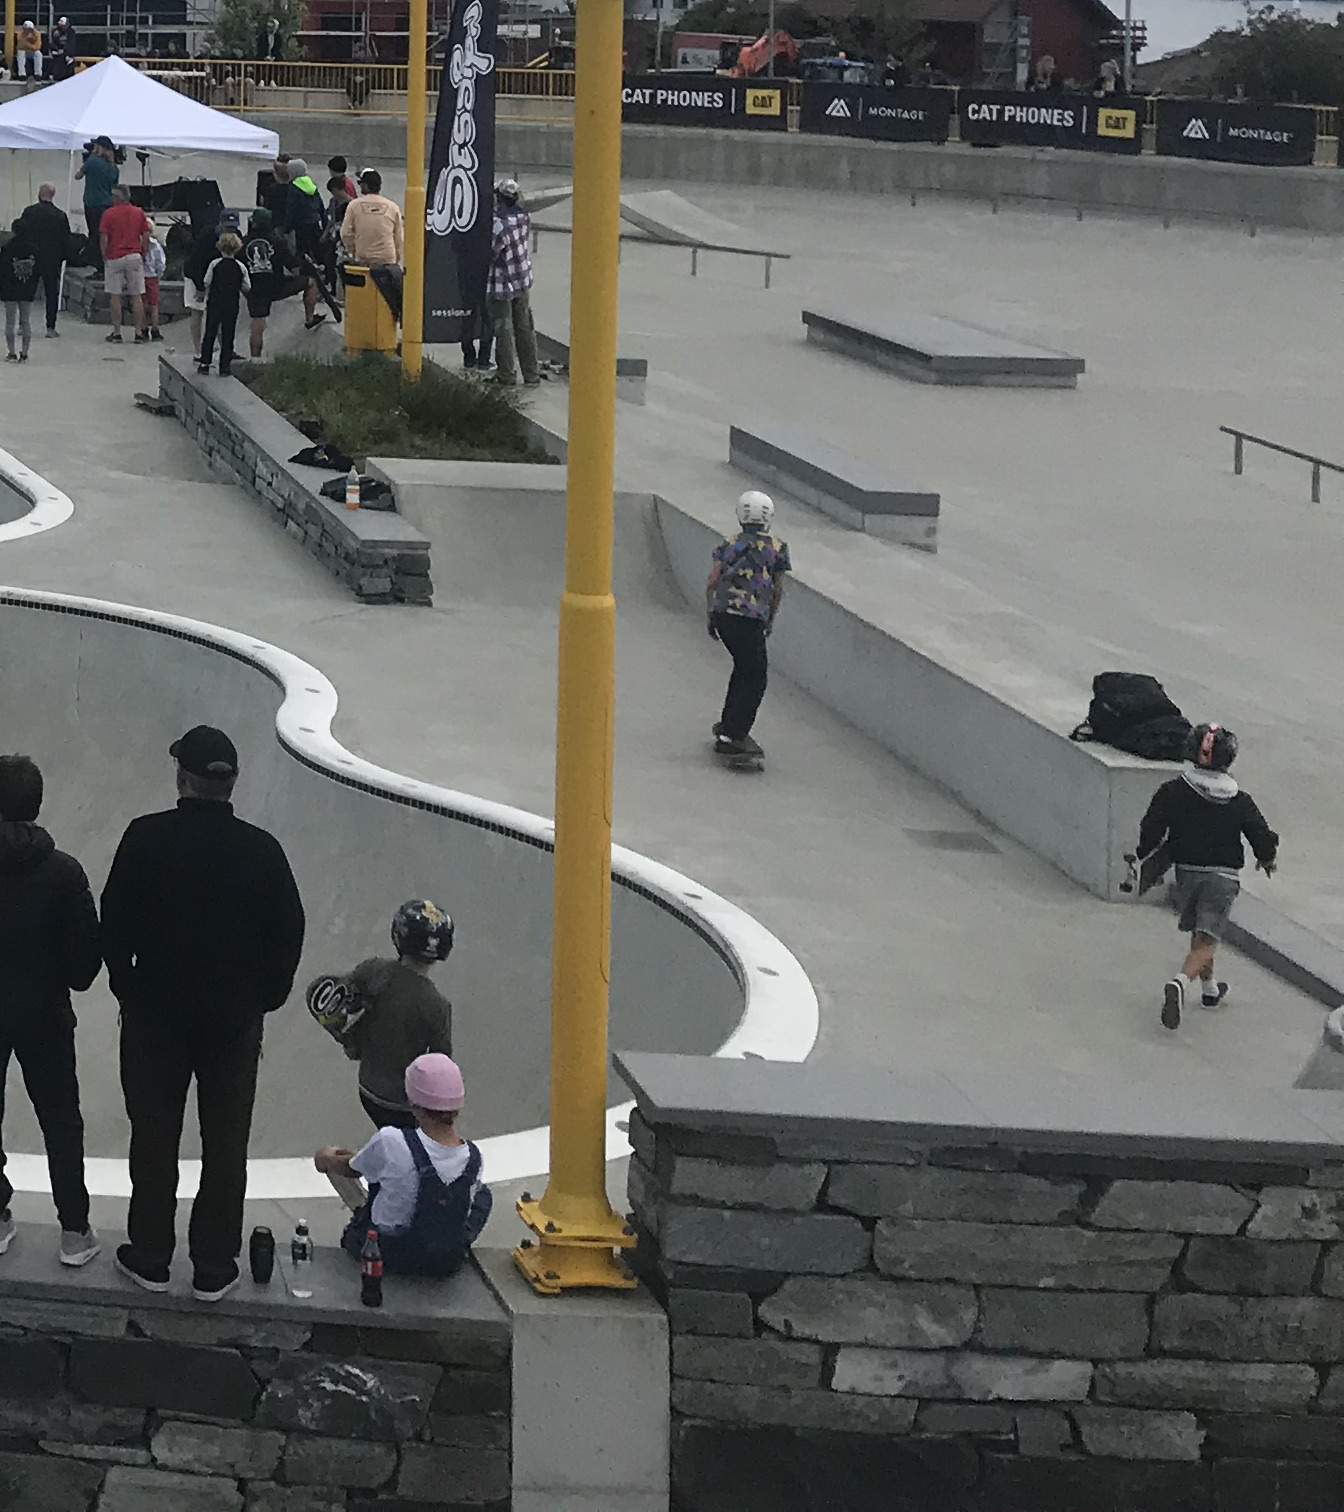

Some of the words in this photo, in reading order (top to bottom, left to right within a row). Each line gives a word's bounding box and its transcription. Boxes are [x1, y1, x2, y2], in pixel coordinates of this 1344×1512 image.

[622, 88, 654, 104] CAT
[656, 90, 724, 108] PHONES
[752, 95, 775, 108] CAT
[868, 106, 926, 120] MONTAGE
[968, 103, 1000, 121] CAT
[1004, 105, 1074, 127] PHONES
[1105, 115, 1127, 130] CAT
[1229, 126, 1289, 143] MONTAGE
